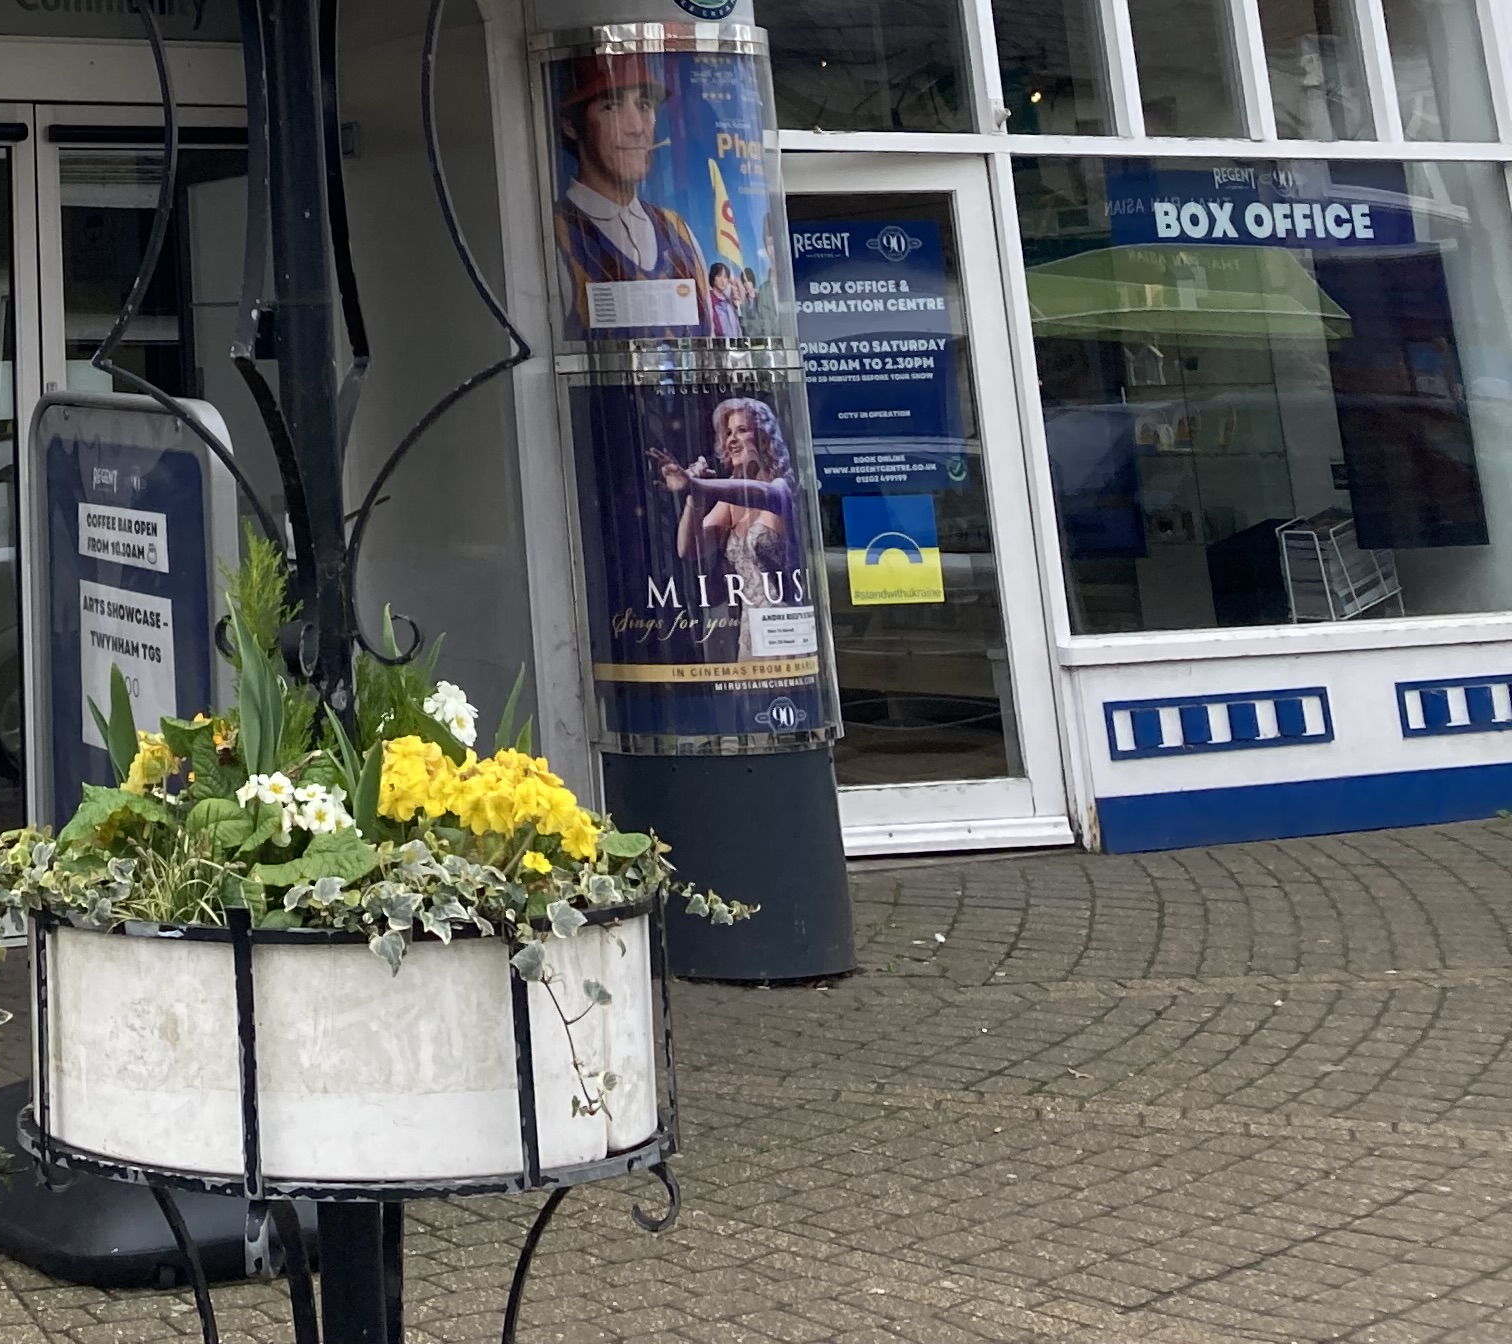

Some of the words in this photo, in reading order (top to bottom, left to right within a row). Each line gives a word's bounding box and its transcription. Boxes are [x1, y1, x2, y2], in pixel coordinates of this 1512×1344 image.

[1212, 167, 1257, 190] REGENT
[1153, 201, 1239, 239] BOX
[1244, 202, 1375, 240] OFFICE
[792, 232, 851, 259] REGENT
[882, 233, 906, 253] 90
[809, 281, 843, 294] BOX
[844, 280, 897, 293] OFFICE
[899, 279, 910, 292] &
[887, 298, 946, 312] CENTRE
[799, 341, 847, 354] ONDAY
[849, 340, 870, 353] TO
[872, 338, 947, 352] SATURDAY
[803, 358, 861, 372] 10.30AM
[862, 358, 883, 370] TO
[884, 356, 935, 370] 2.30PM
[829, 374, 861, 382] MINUTES
[862, 373, 889, 381] BEFORE
[910, 372, 934, 380] SHOW
[869, 410, 911, 418] OPERATION
[86, 513, 117, 531] COFFEE
[117, 517, 133, 534] BAR
[133, 520, 158, 537] OPEN
[87, 536, 109, 554] FROM
[110, 540, 145, 560] 10.30AM
[854, 587, 943, 600] #standwithukraine
[82, 595, 105, 615] ARTS
[106, 601, 161, 629] SHOWCASE
[611, 607, 664, 644] Sings
[657, 609, 699, 642] for
[695, 617, 738, 644] you
[90, 630, 140, 658] TWYNHAM
[141, 642, 162, 663] TGS
[672, 668, 685, 678] IN
[690, 665, 747, 678] CINEMAS
[752, 663, 782, 675] FROM
[772, 705, 795, 727] 90
